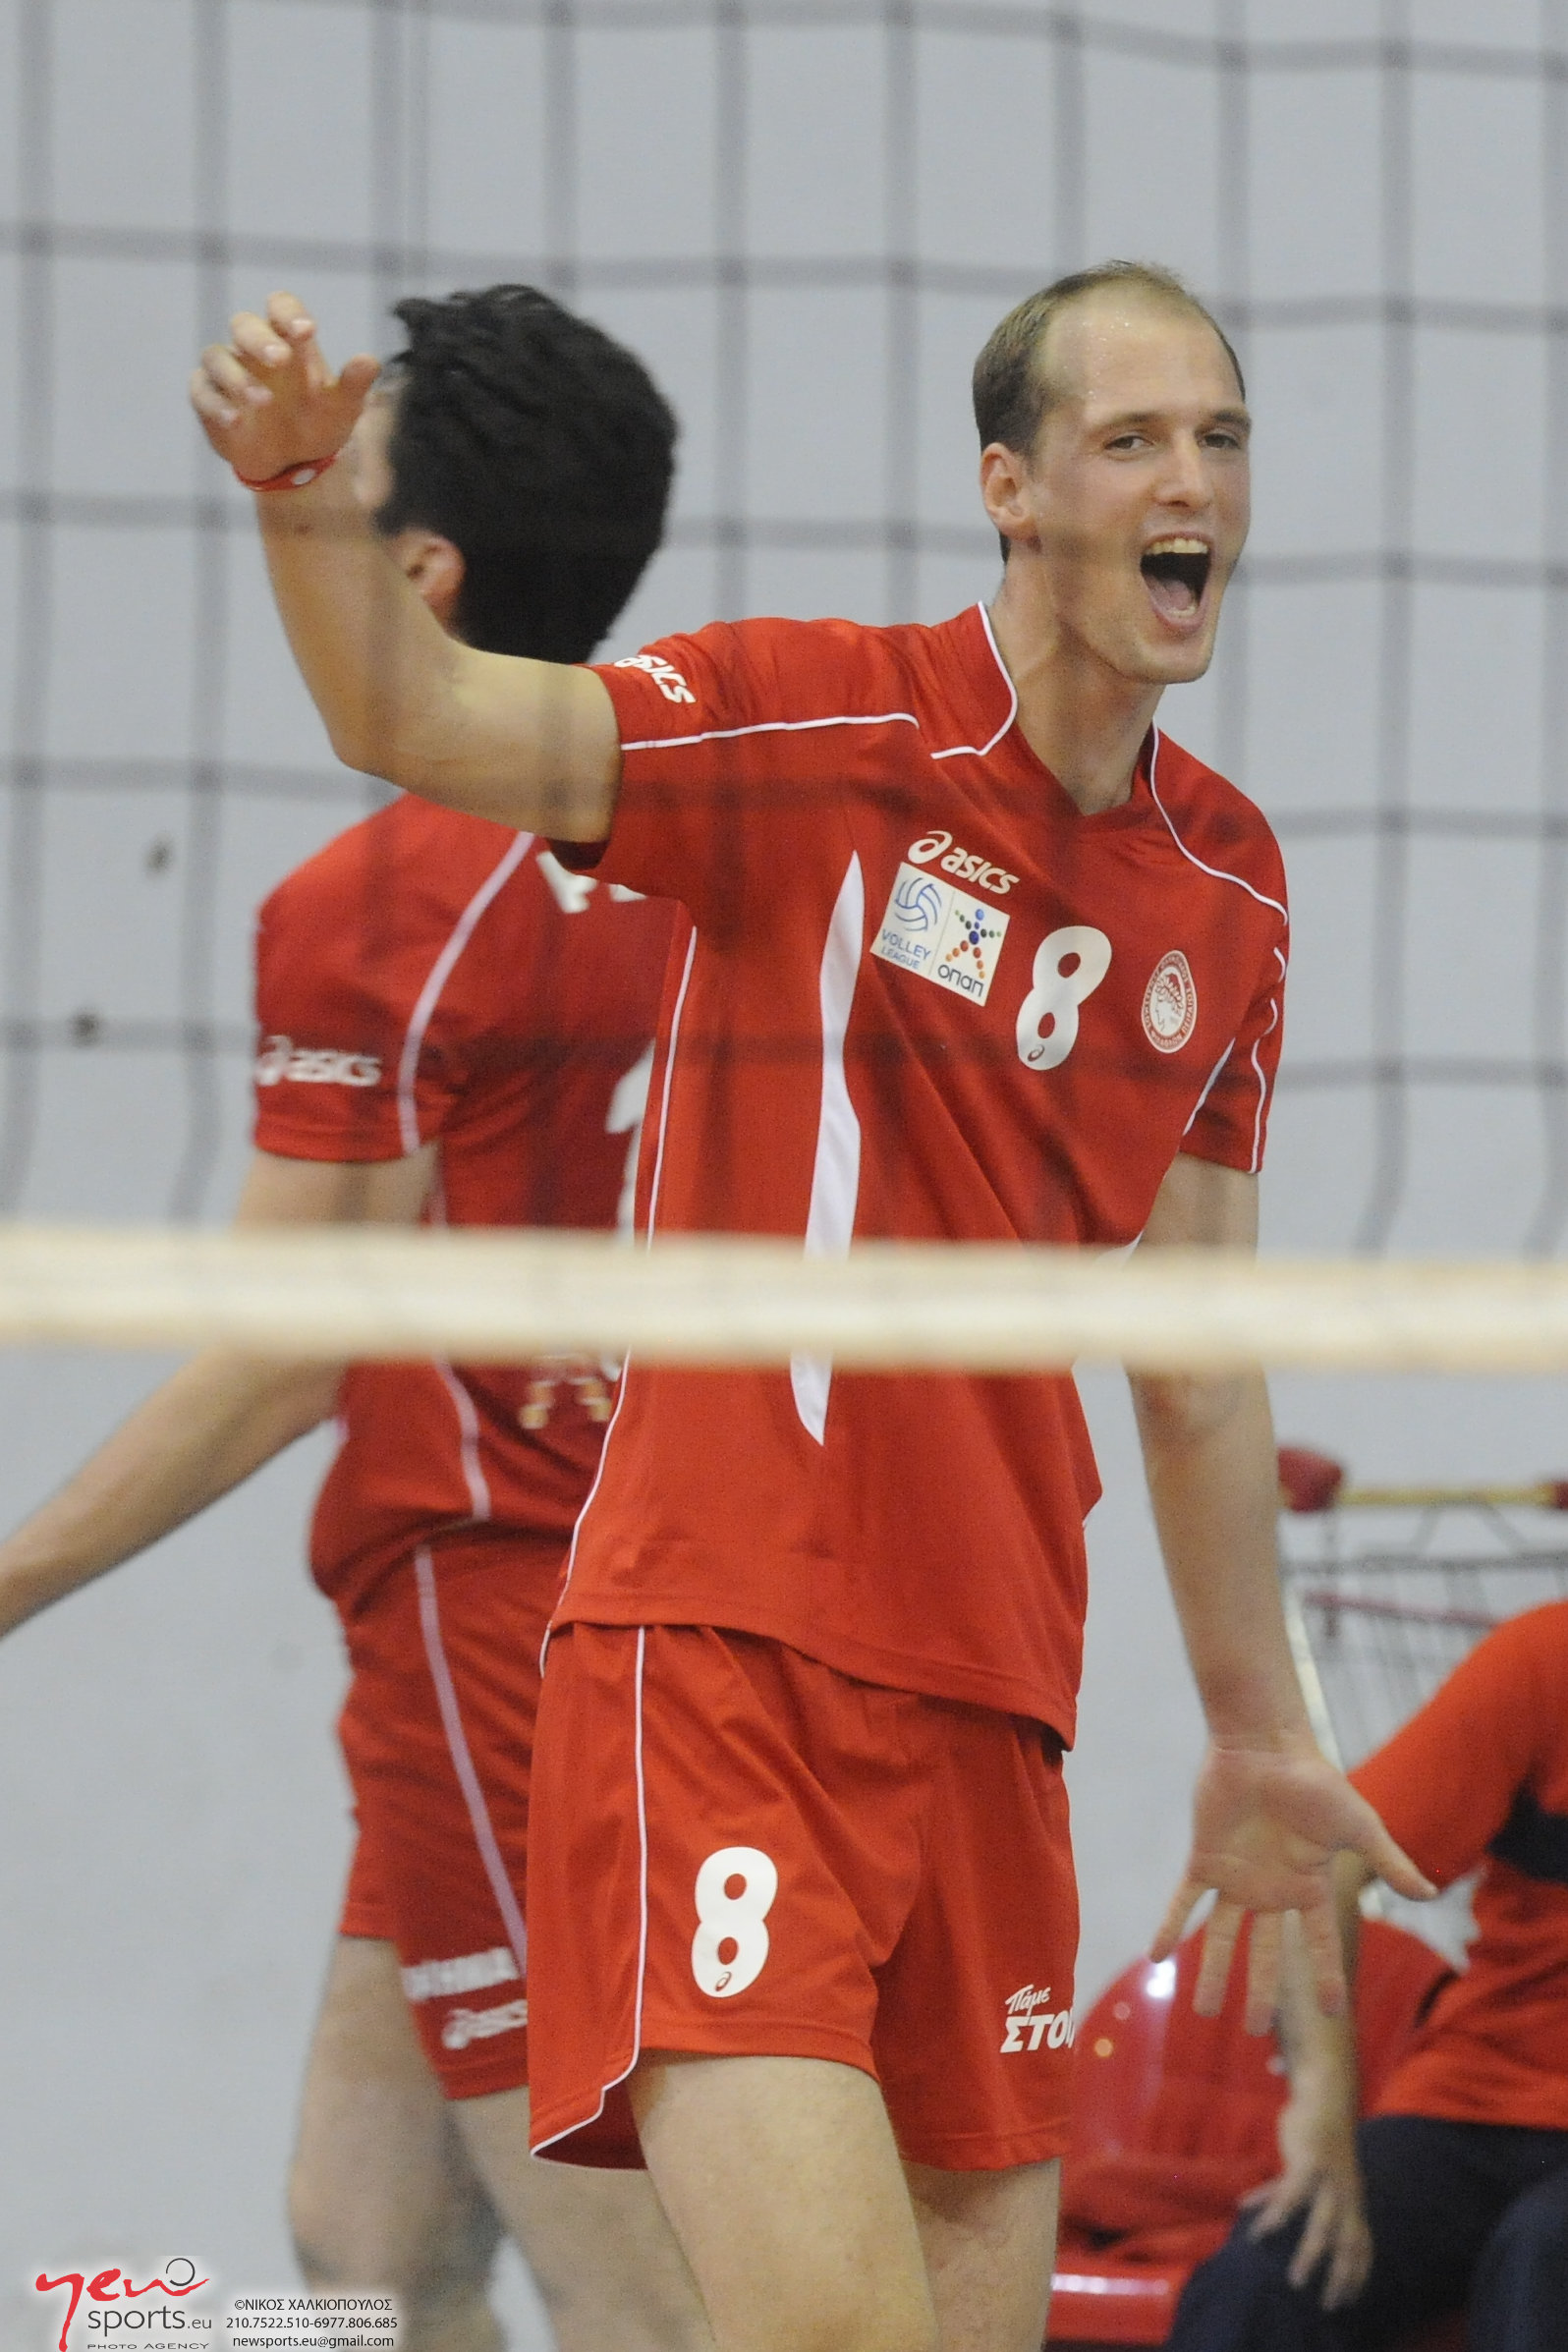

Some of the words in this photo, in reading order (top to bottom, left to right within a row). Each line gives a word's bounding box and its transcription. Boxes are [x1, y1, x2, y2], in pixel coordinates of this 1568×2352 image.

[940, 846, 1021, 895] asics
[880, 946, 921, 970] LEAGUE
[882, 928, 931, 960] VOLLEY
[1016, 925, 1112, 1071] 8
[691, 1846, 779, 1998] 8
